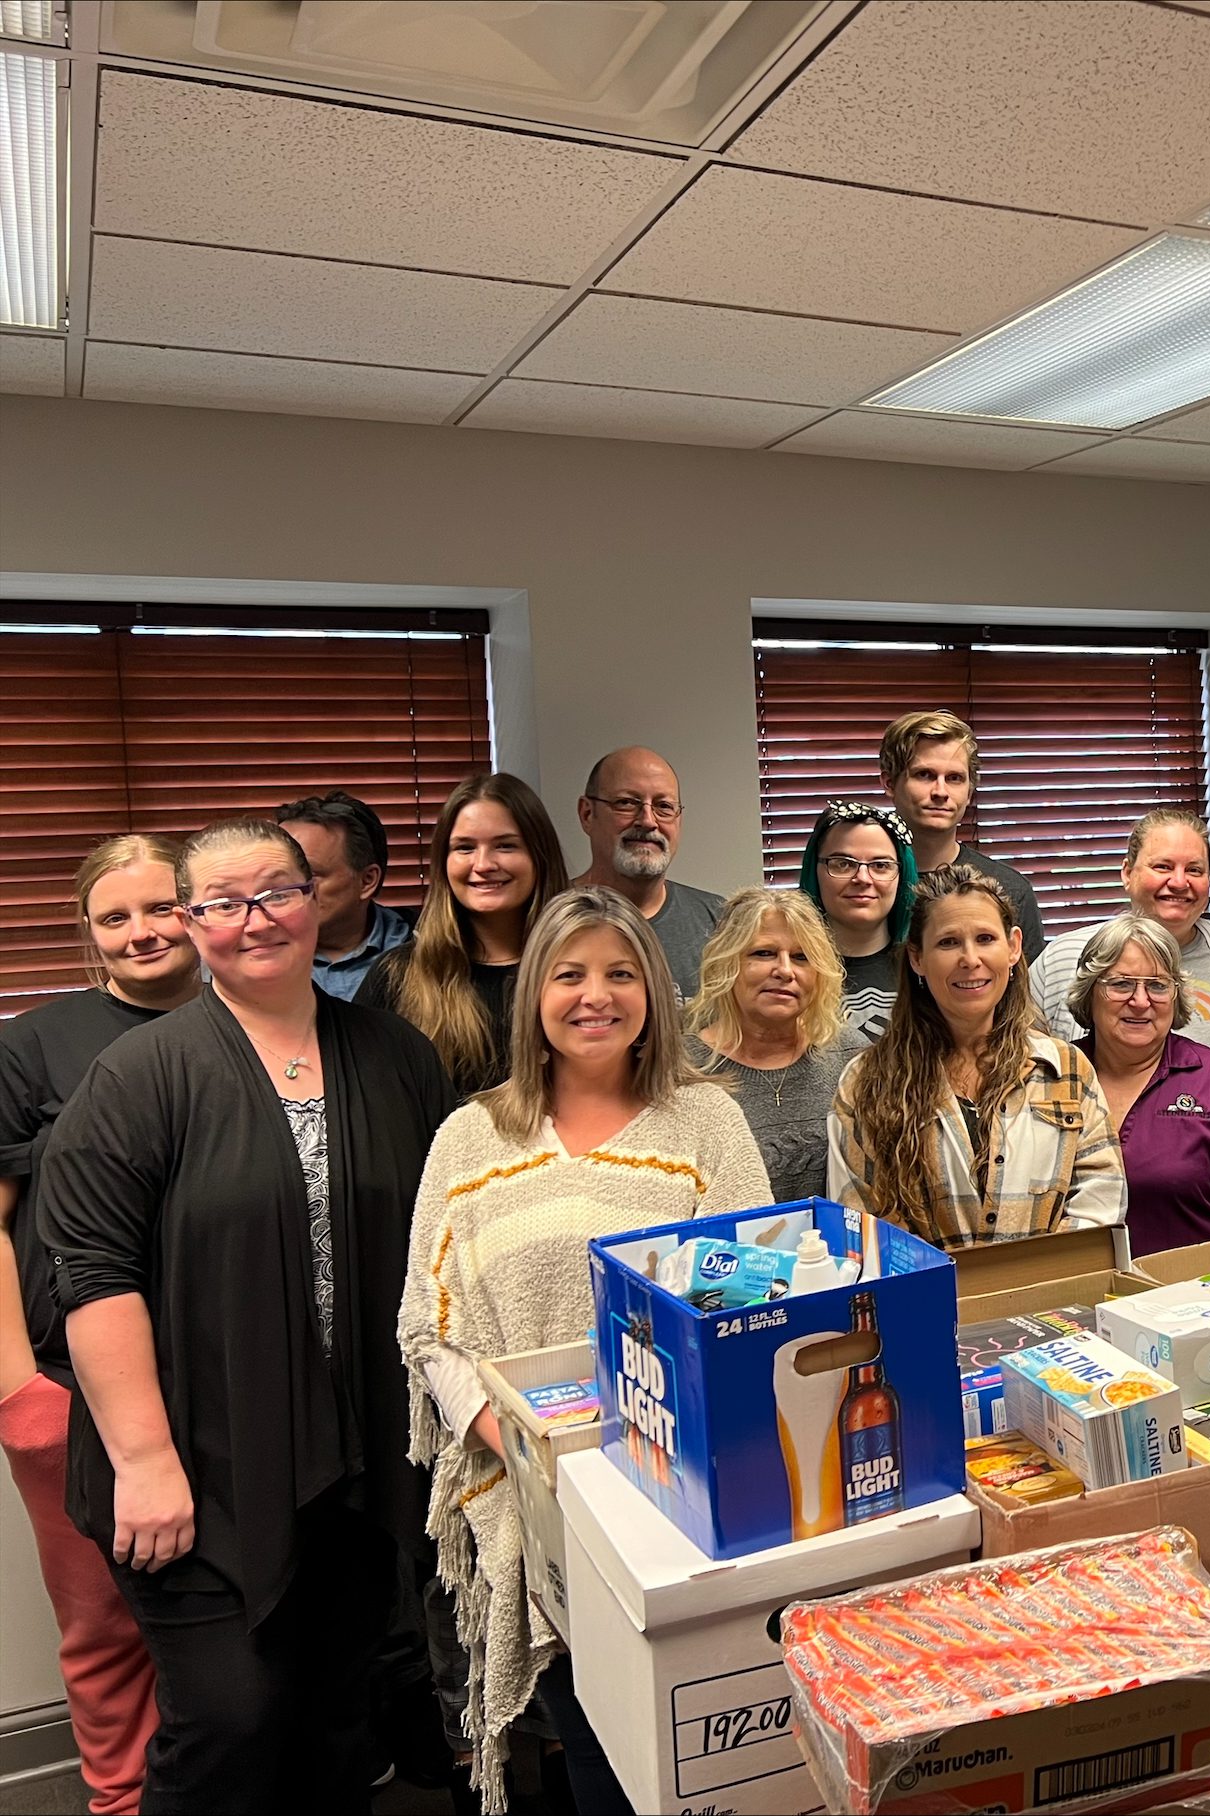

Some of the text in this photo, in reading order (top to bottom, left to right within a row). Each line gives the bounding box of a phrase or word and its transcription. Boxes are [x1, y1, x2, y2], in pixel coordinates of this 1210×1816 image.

[701, 1254, 739, 1273] Dial
[745, 1253, 776, 1266] spring
[716, 1318, 743, 1338] 24
[748, 1314, 759, 1323] 12
[748, 1316, 788, 1331] BOTTLES
[1037, 1341, 1114, 1383] SALTINE
[1161, 1339, 1170, 1360] 100
[621, 1332, 665, 1401] BUD
[616, 1371, 675, 1457] LIGHT
[1145, 1417, 1162, 1476] SALTINE
[851, 1455, 894, 1482] BUD
[846, 1470, 900, 1501] LIGHT
